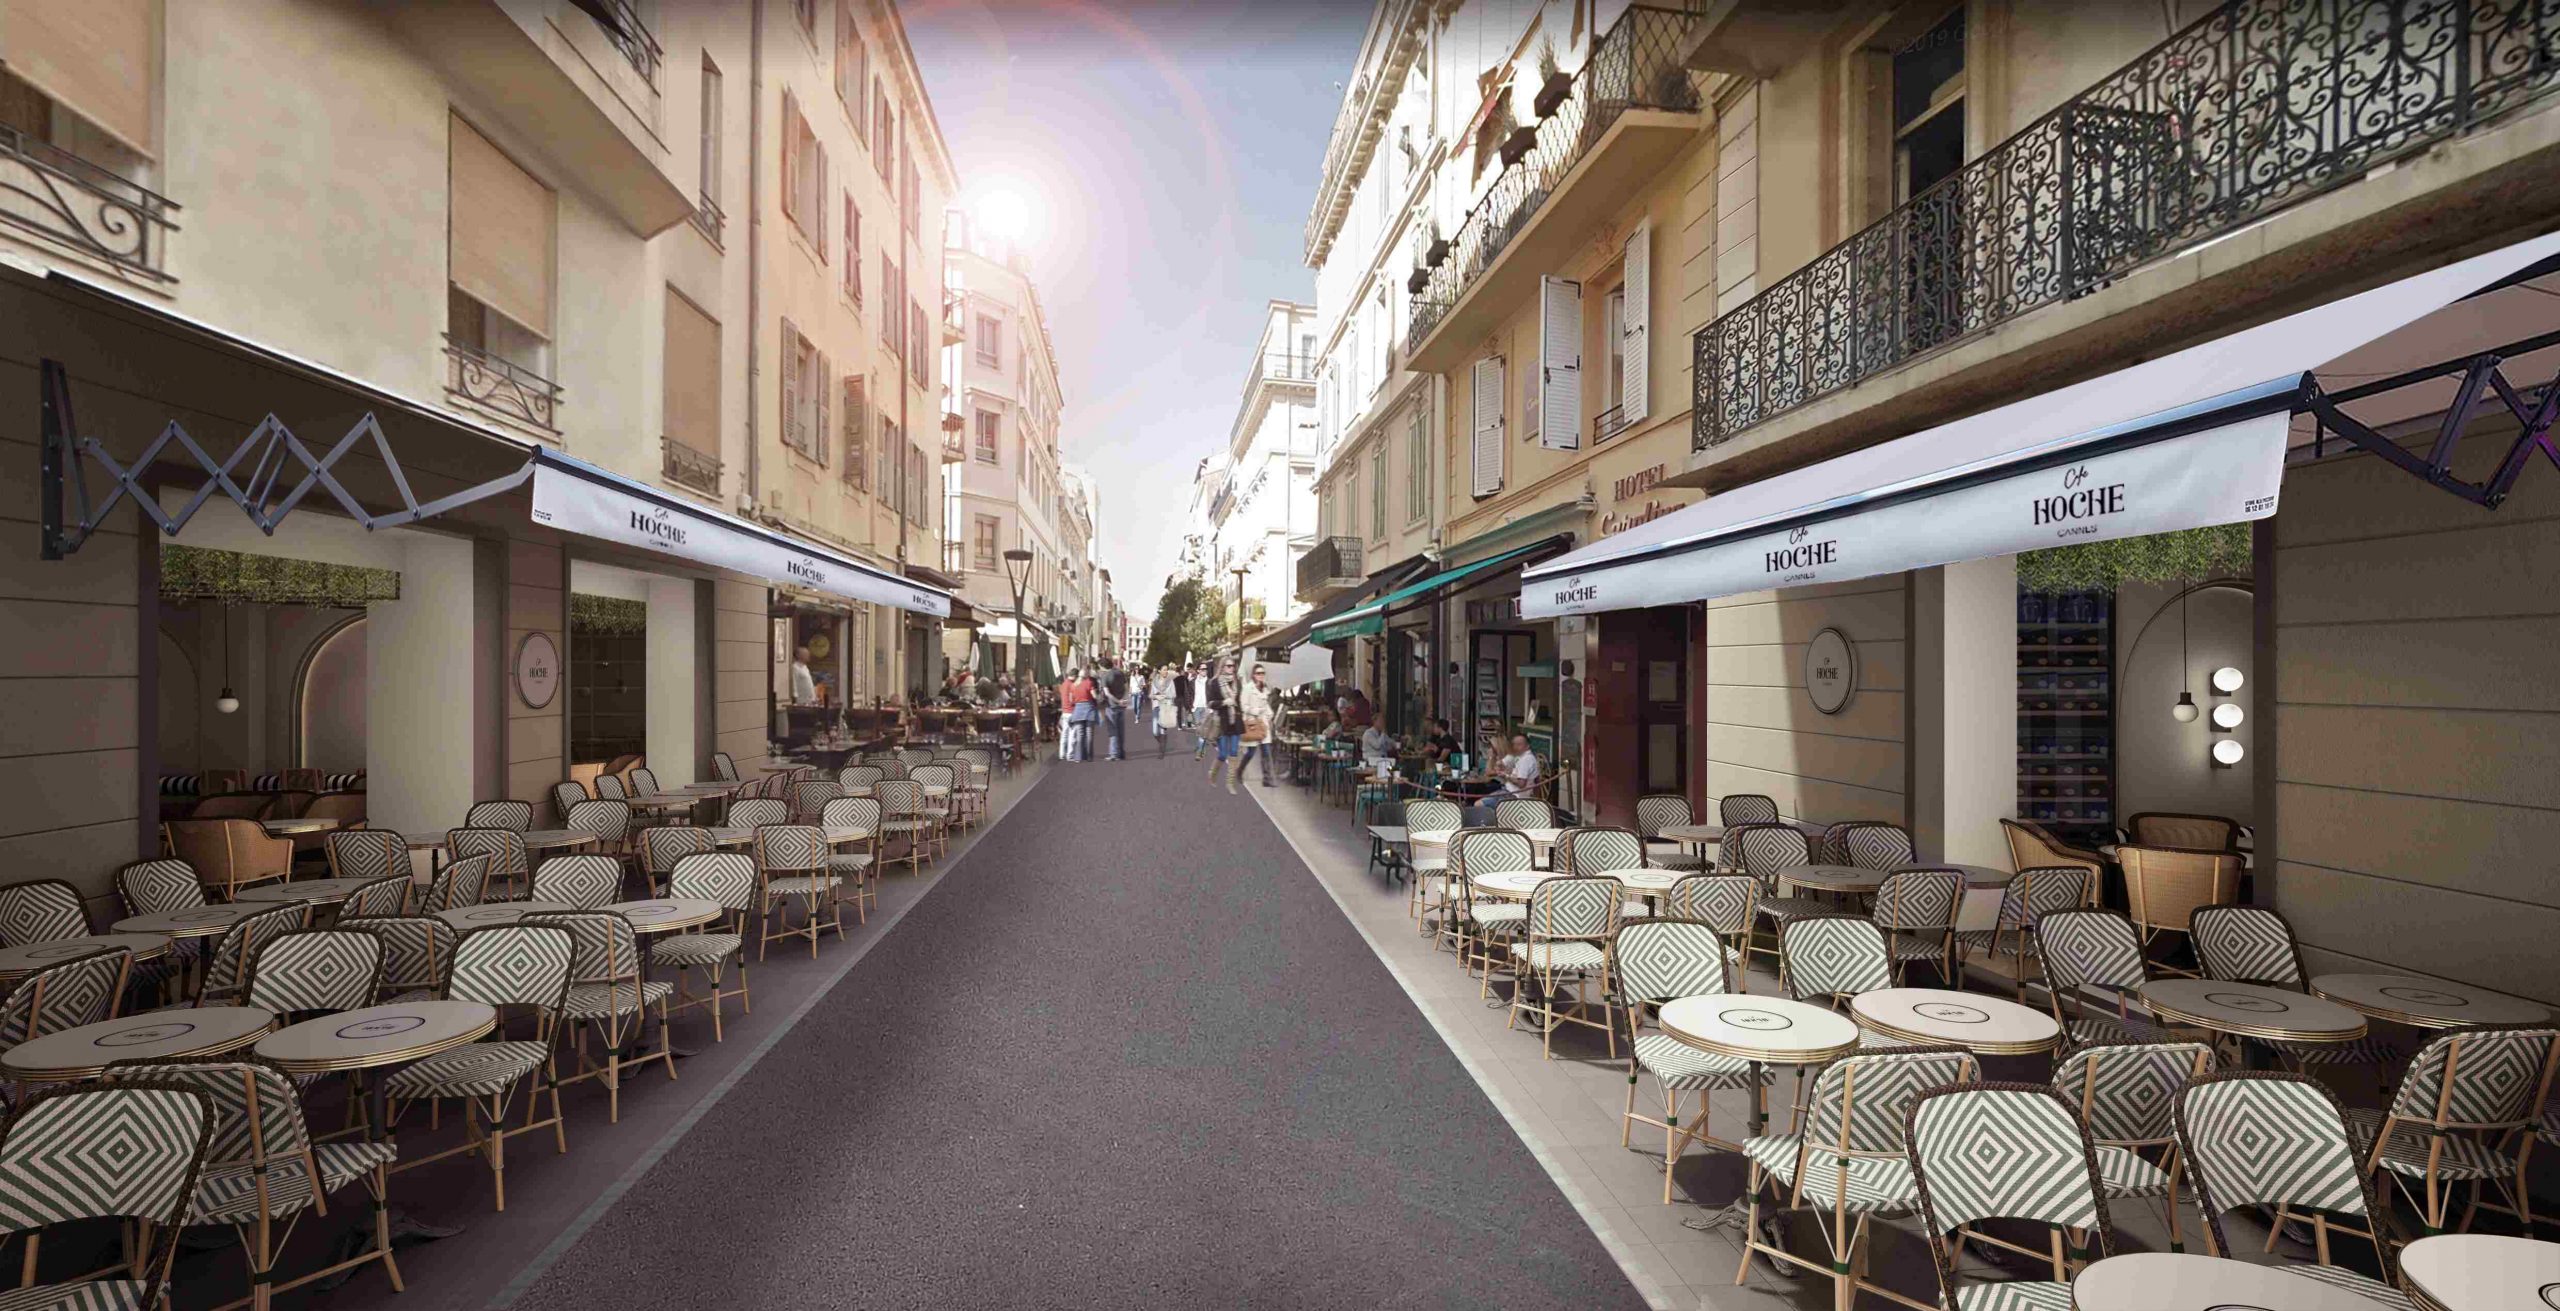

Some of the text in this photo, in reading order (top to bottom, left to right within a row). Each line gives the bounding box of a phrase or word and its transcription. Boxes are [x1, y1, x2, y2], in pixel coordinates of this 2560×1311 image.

[2033, 482, 2125, 525] HOCHE
[631, 510, 686, 544] HOCHE
[787, 559, 826, 584] HOCHE
[1765, 540, 1837, 573] HOCHE
[1555, 585, 1598, 605] HOCHE
